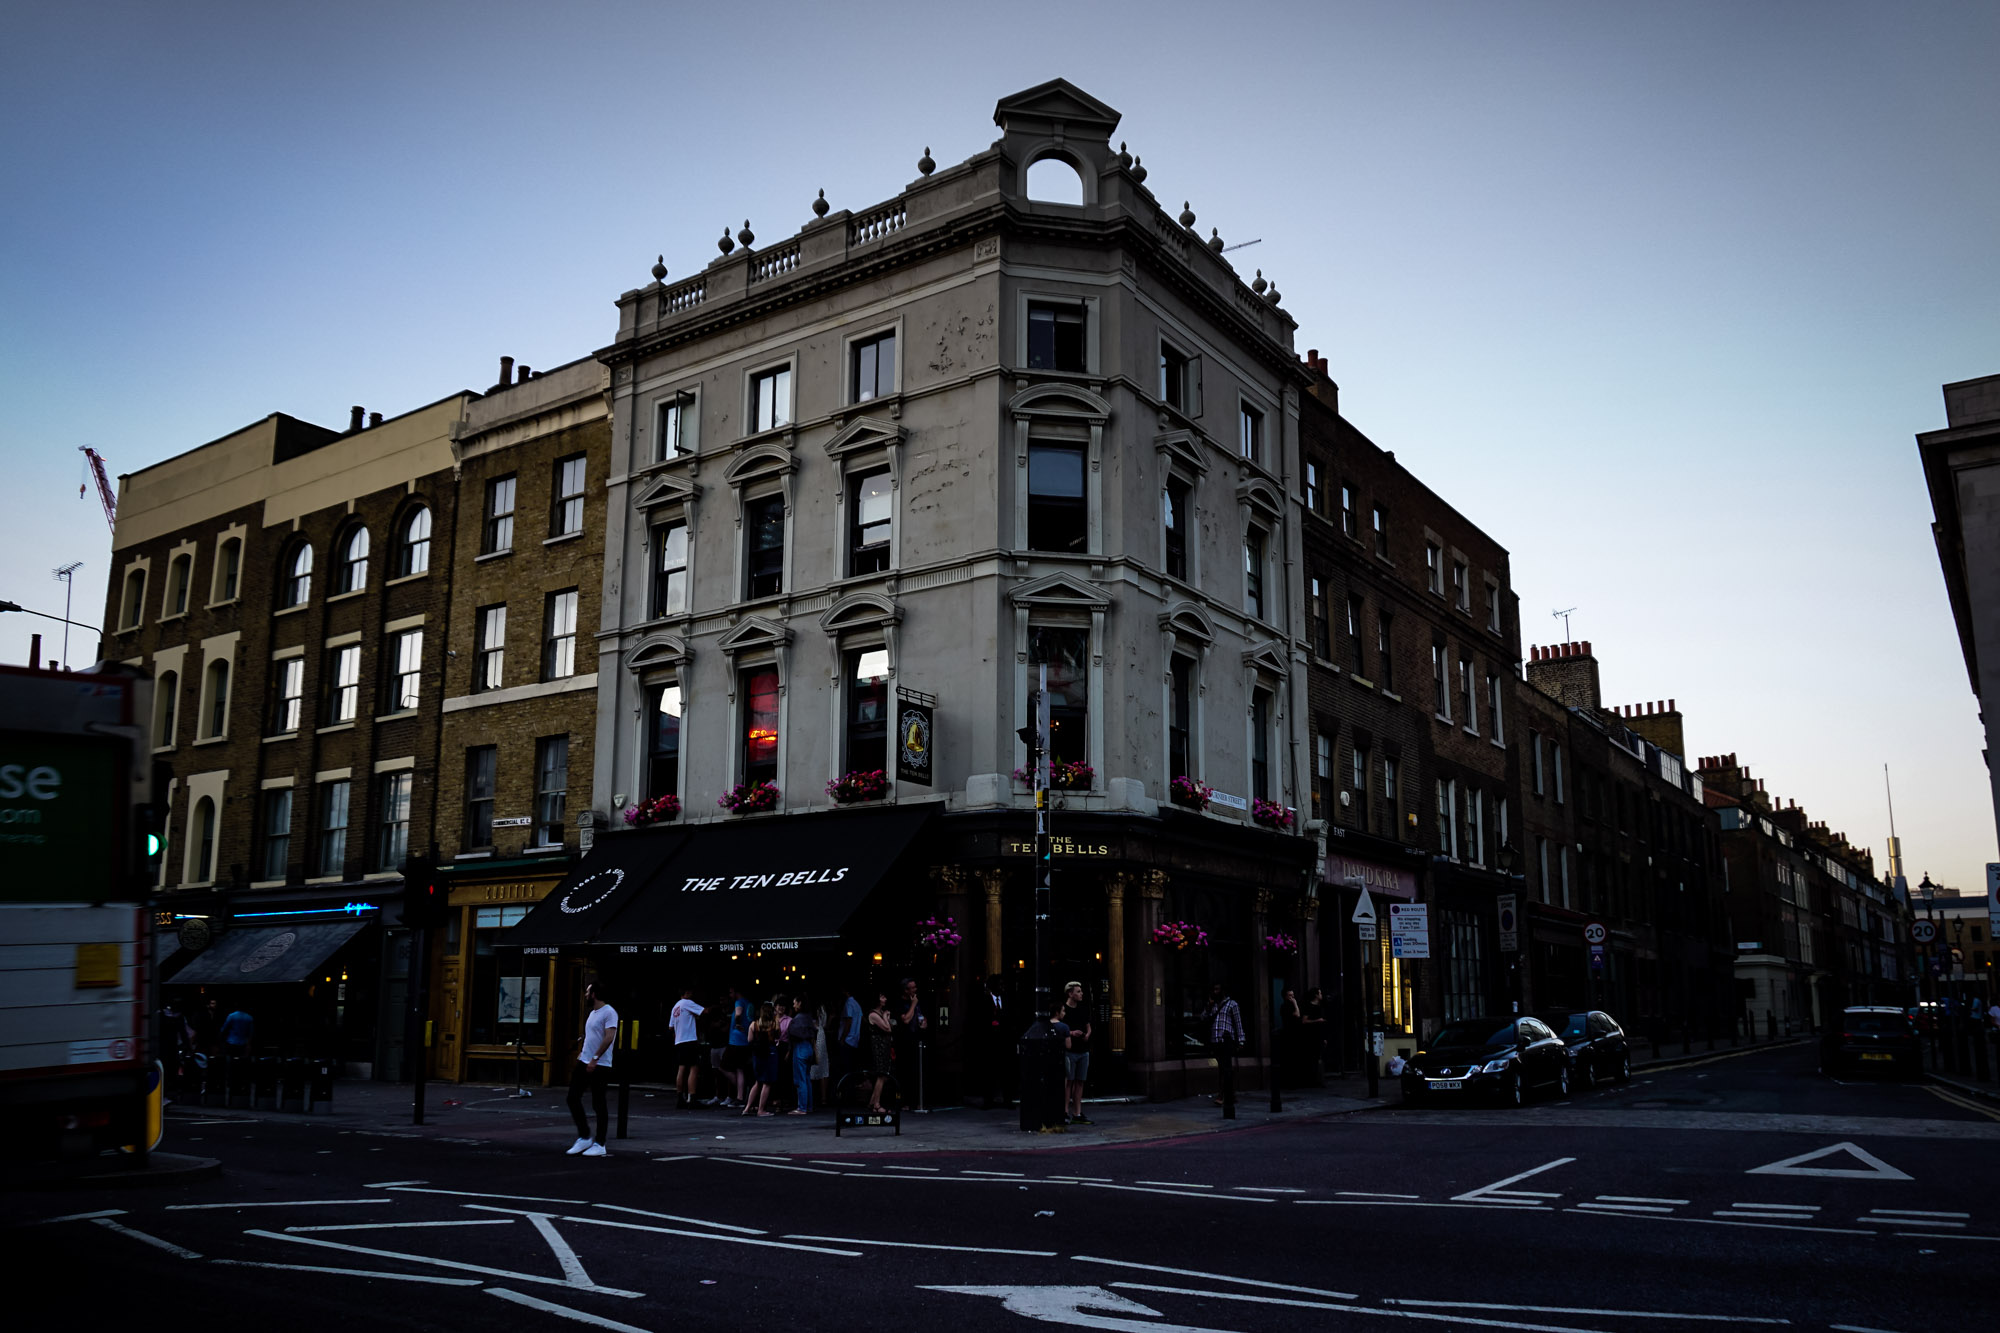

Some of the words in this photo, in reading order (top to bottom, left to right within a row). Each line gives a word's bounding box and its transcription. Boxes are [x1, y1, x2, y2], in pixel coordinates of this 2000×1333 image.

[0, 764, 62, 800] se
[1049, 836, 1072, 844] THE
[1053, 844, 1108, 855] BELLS
[681, 877, 725, 892] THE
[728, 874, 775, 890] TEN
[775, 867, 849, 887] BELLS
[485, 884, 534, 900] CUBITTS
[1586, 927, 1604, 939] 20
[1913, 925, 1934, 937] 20
[523, 947, 548, 955] UPSTAIRS
[619, 945, 638, 953] BEERS
[652, 945, 667, 953] ALES
[682, 944, 703, 952] WINES
[719, 943, 744, 952] SPIRITS
[760, 941, 799, 951] COCKTAILS
